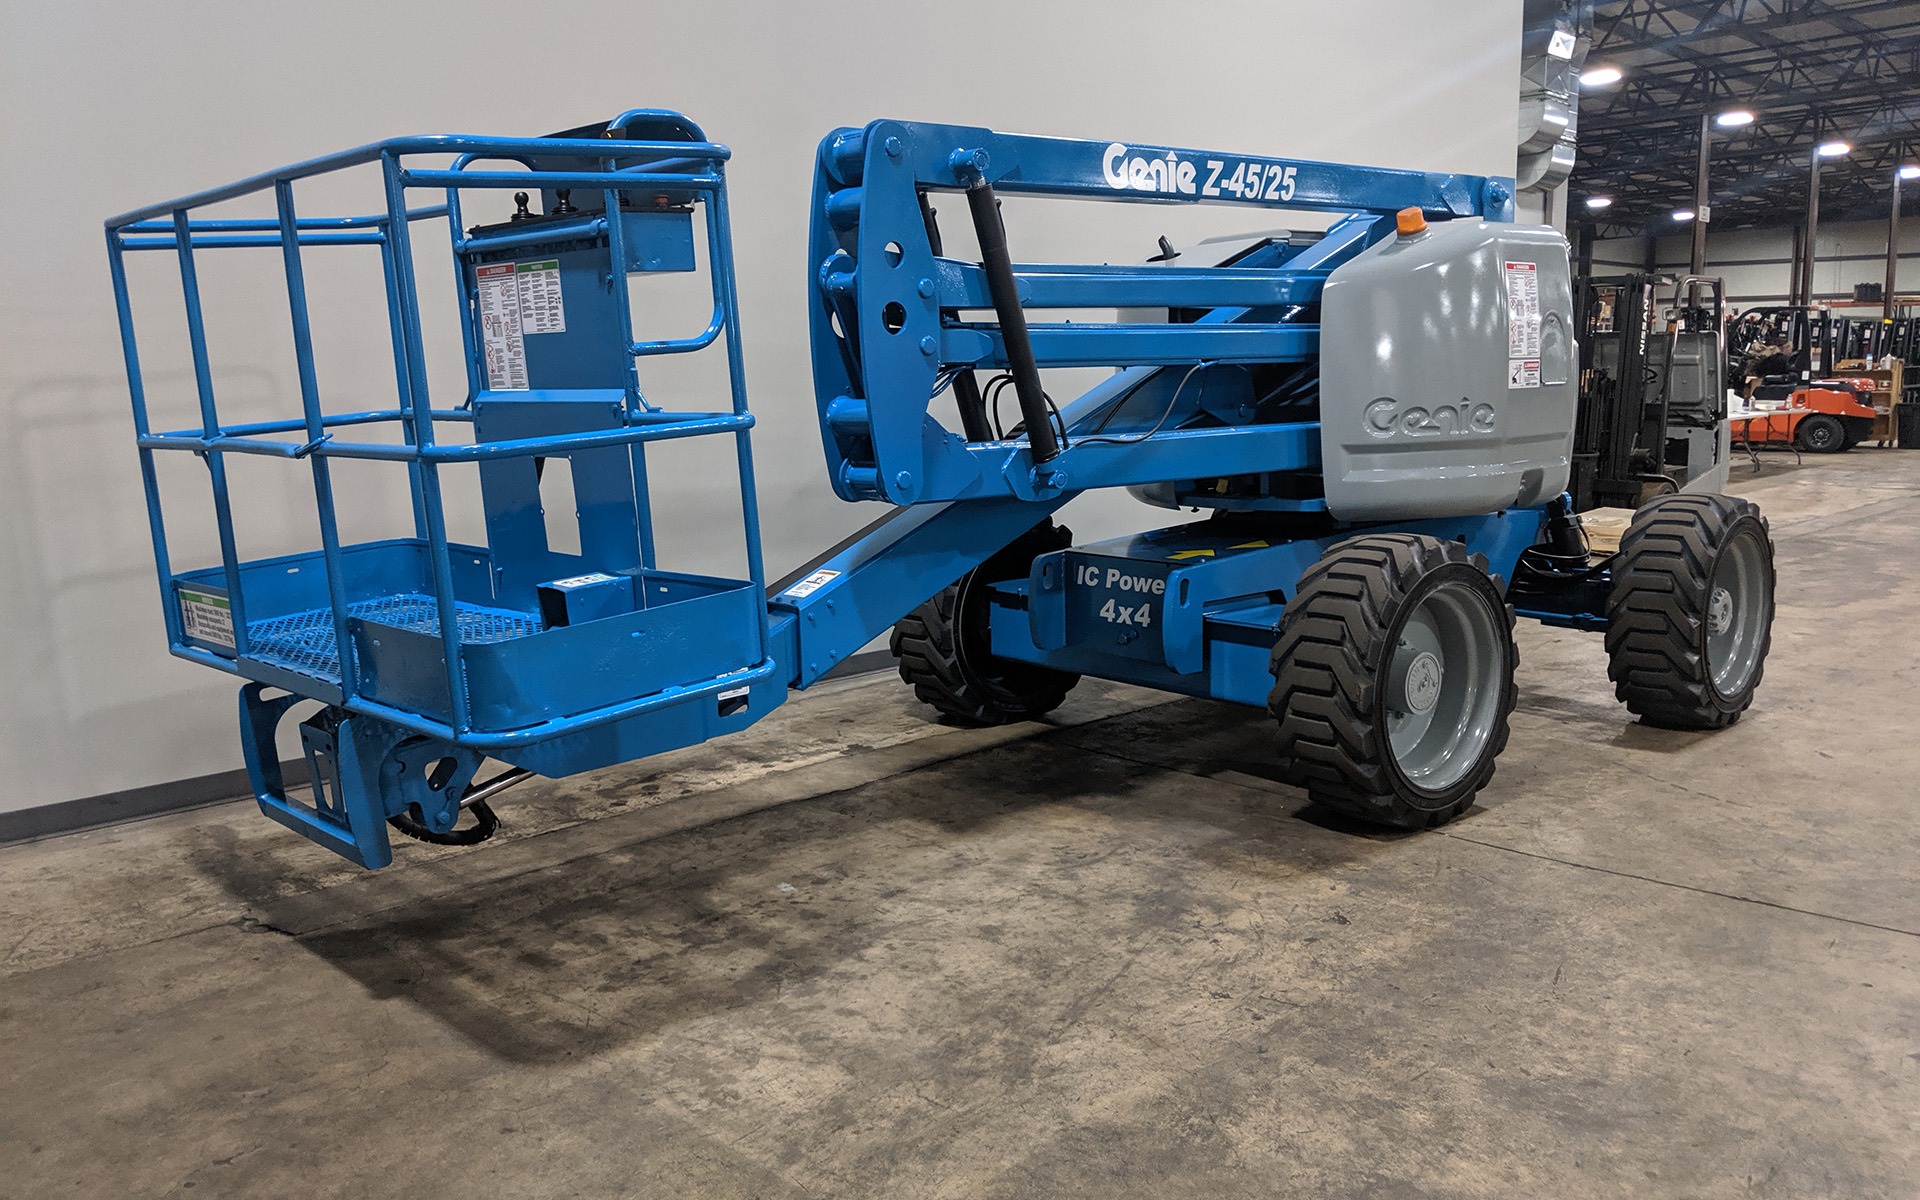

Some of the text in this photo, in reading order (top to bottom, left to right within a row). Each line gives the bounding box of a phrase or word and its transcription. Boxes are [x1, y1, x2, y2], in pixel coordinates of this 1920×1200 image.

[1102, 142, 1298, 201] Genie Z-45/25
[1639, 298, 1649, 356] NISSAN
[1362, 396, 1496, 439] Genie
[1076, 565, 1166, 595] IC Powe
[1099, 598, 1151, 628] 4x4
